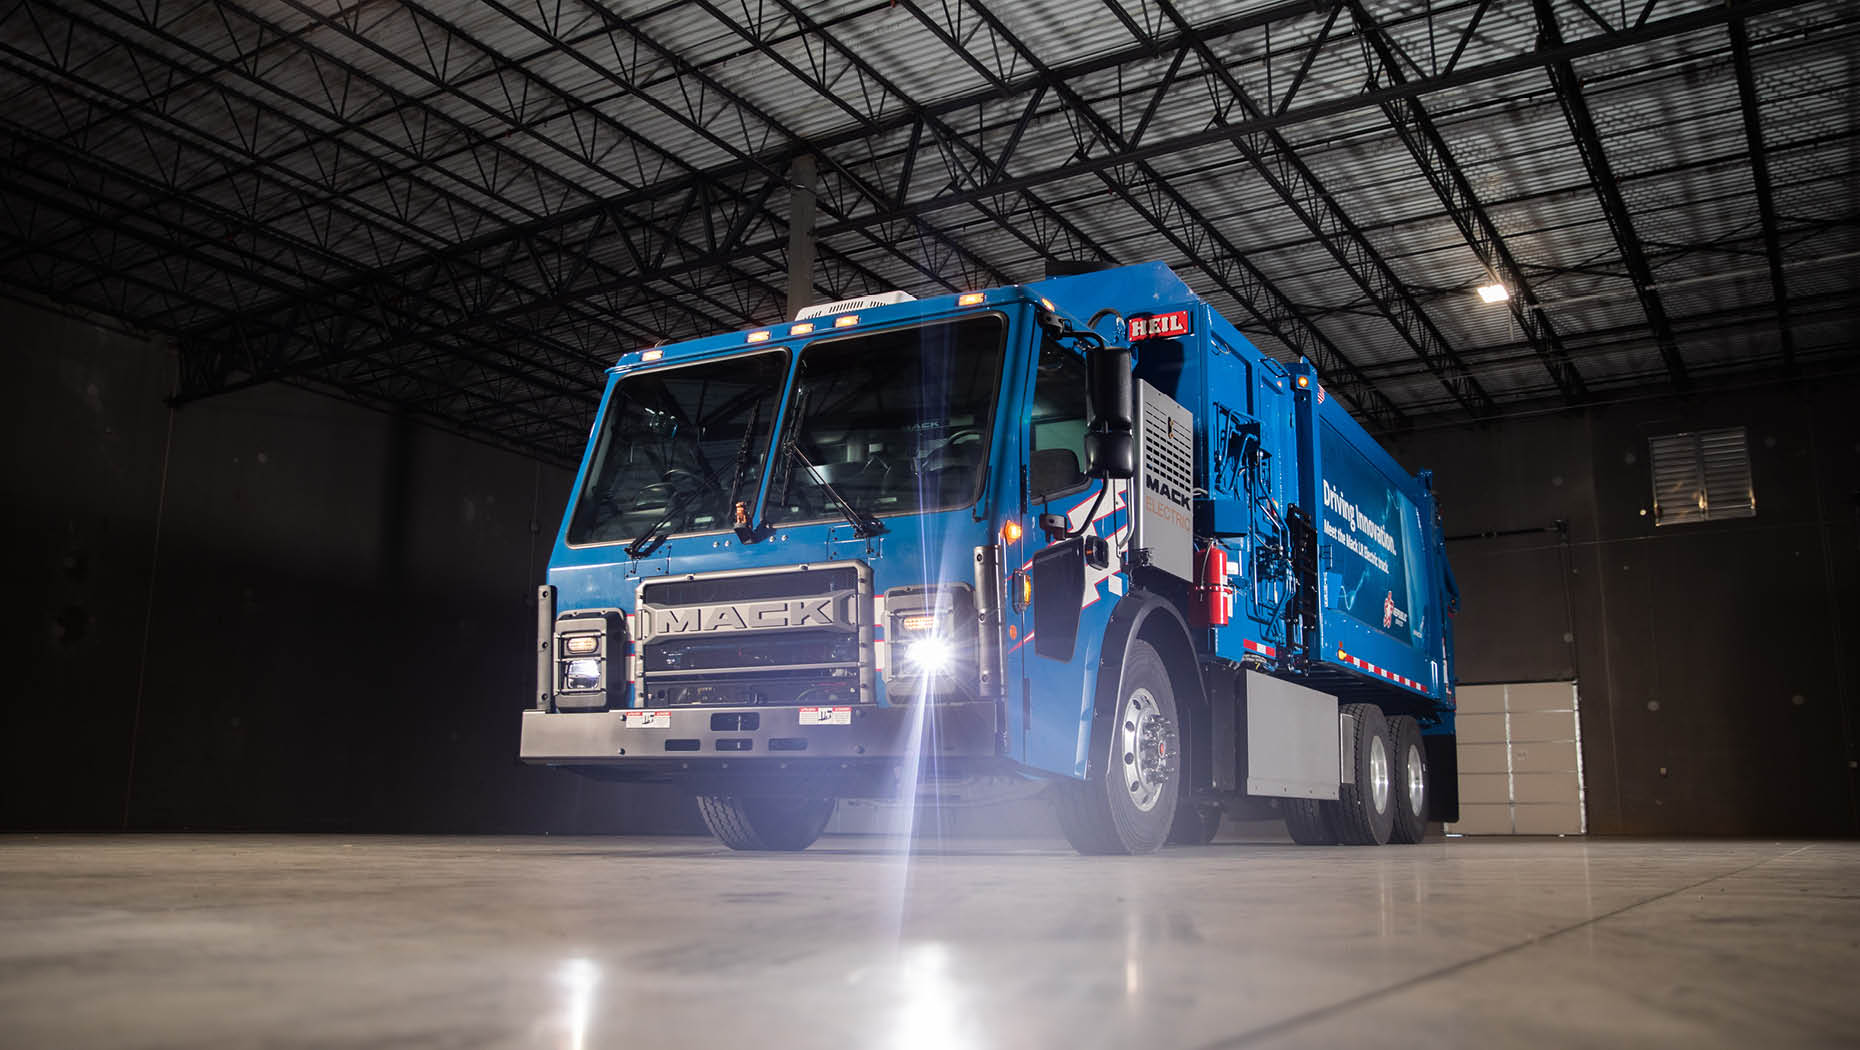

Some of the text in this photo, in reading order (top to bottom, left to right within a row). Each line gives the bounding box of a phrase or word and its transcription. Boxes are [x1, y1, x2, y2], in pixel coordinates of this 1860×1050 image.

[1132, 315, 1184, 337] HEIL
[1146, 473, 1191, 512] MACK
[1146, 495, 1192, 532] ELECTRIC
[1323, 479, 1397, 556] Driving Innovation.
[1323, 519, 1338, 540] Meet
[1338, 528, 1346, 546] the
[657, 600, 833, 634] MACK
